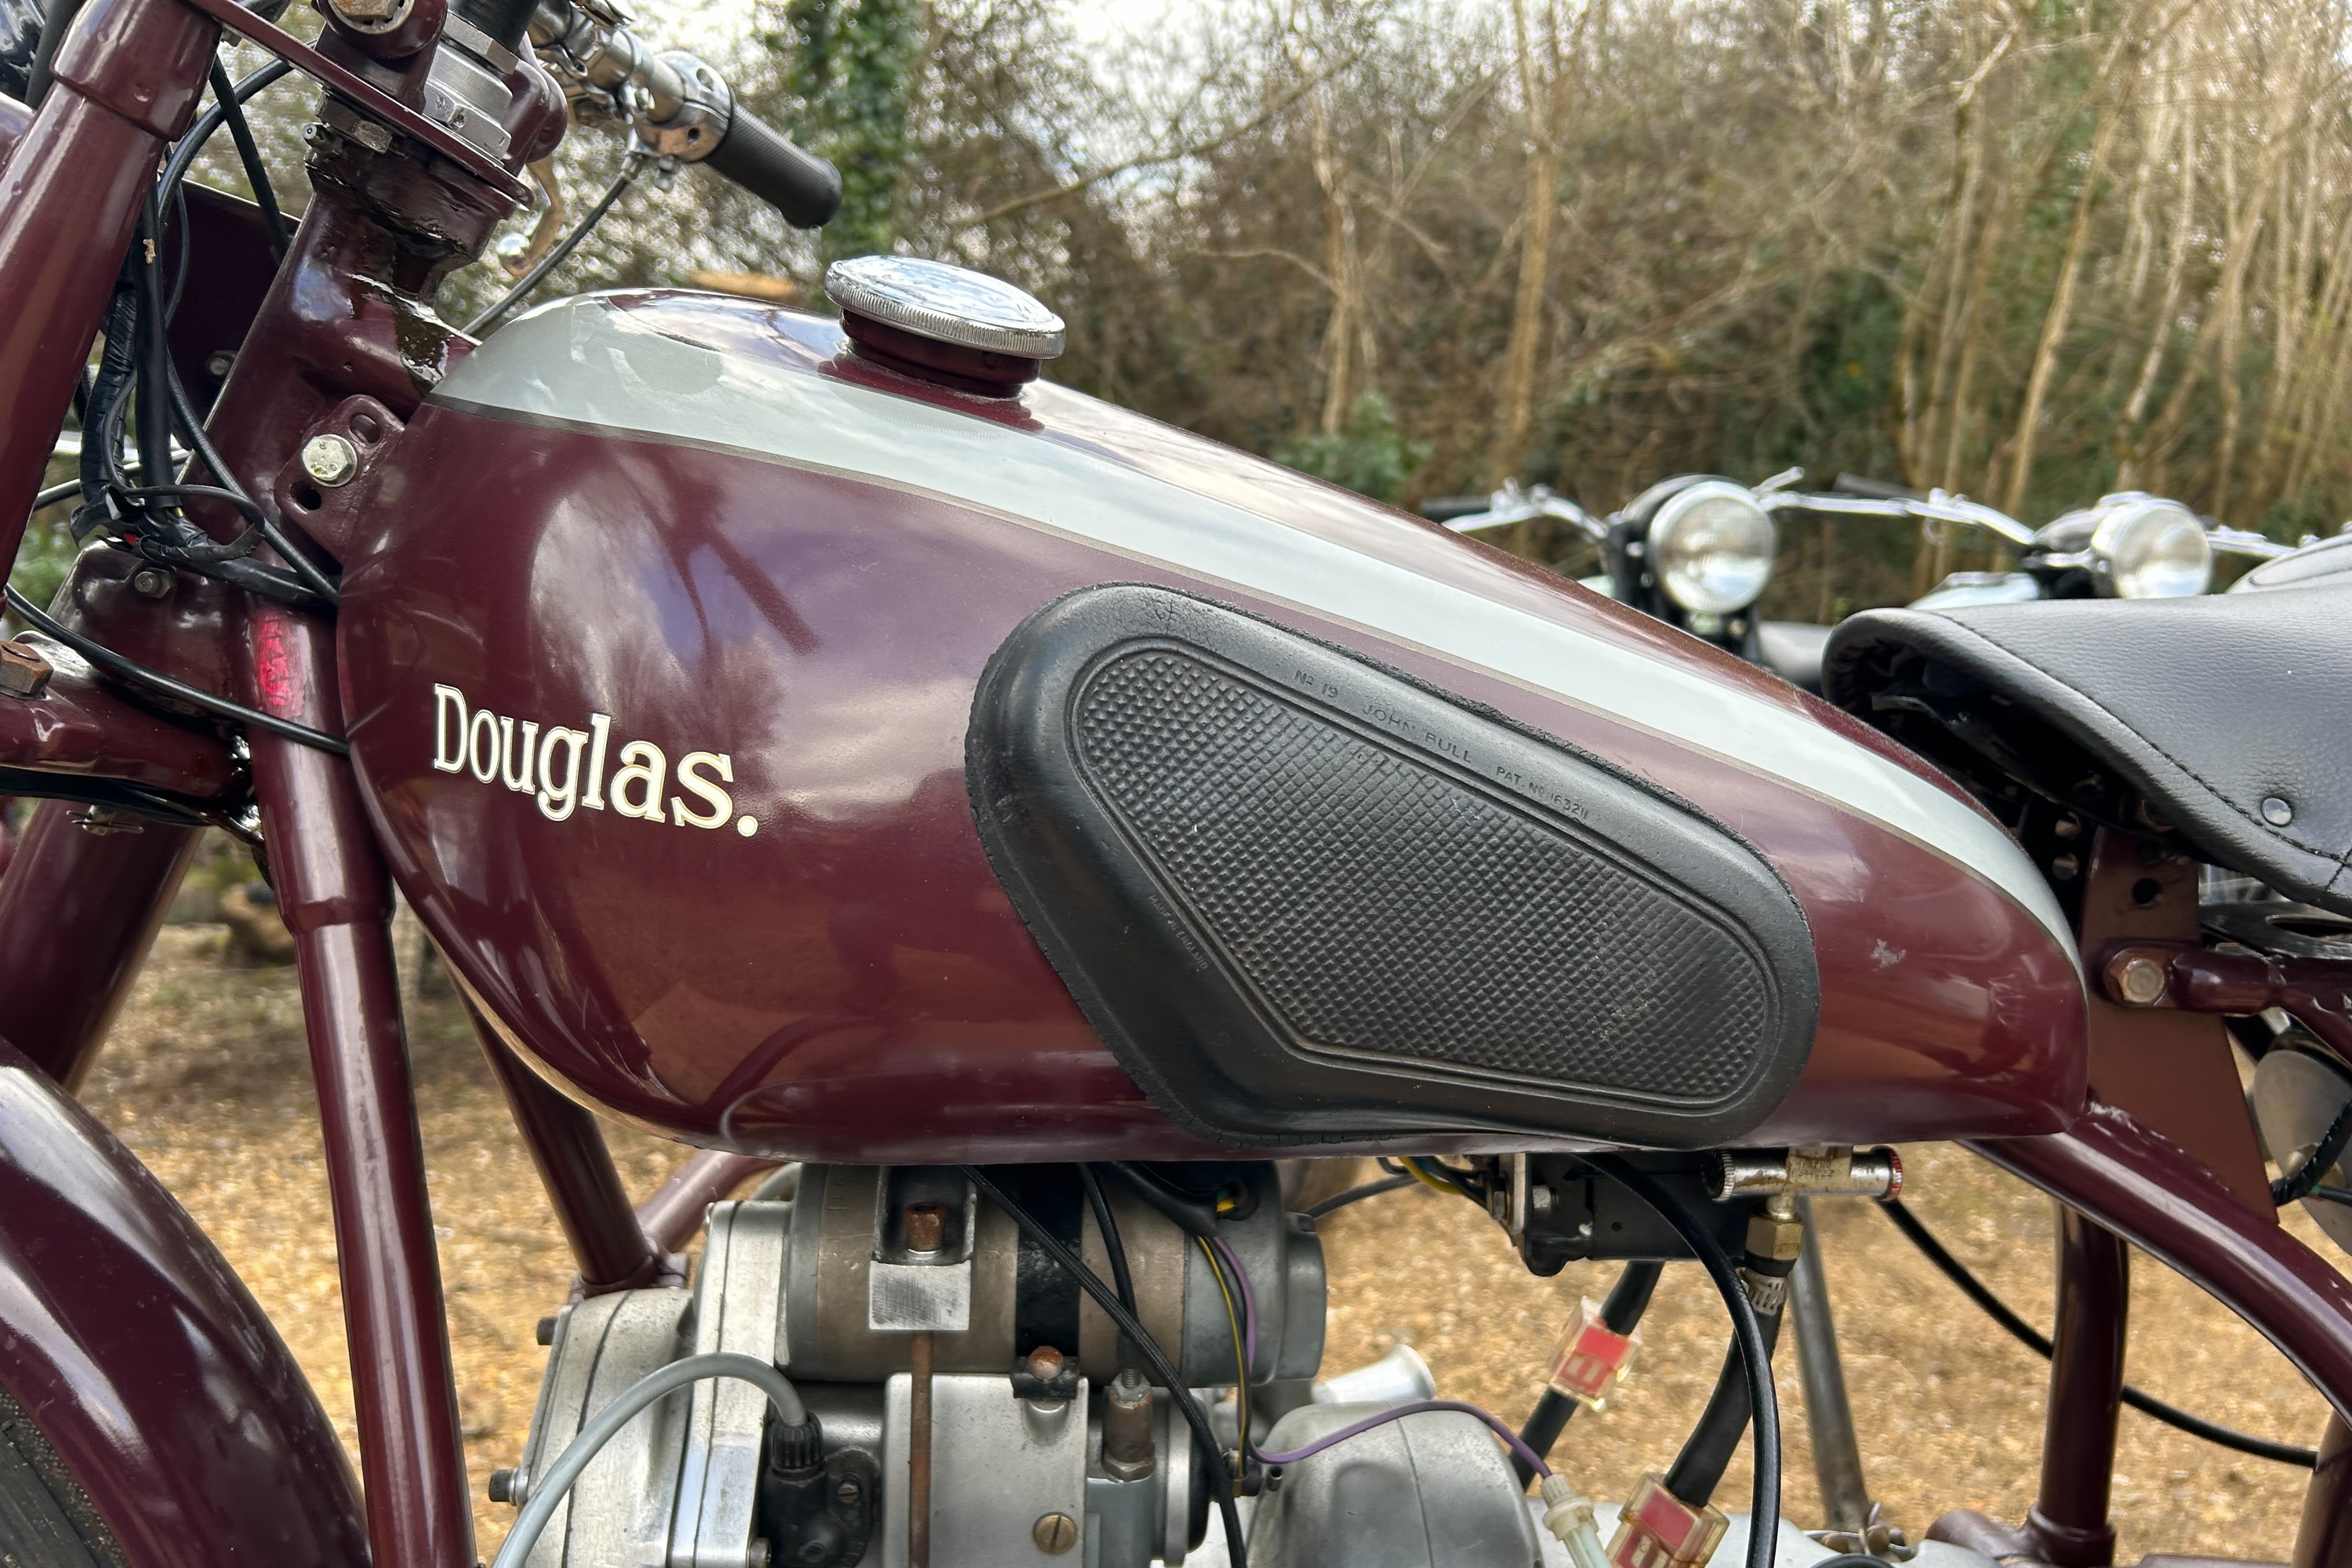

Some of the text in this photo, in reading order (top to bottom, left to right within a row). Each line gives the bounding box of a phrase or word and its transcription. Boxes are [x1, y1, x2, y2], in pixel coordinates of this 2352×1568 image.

[434, 682, 759, 837] Douglas.
[1321, 682, 1339, 699] 19
[1425, 731, 1472, 764] BULL
